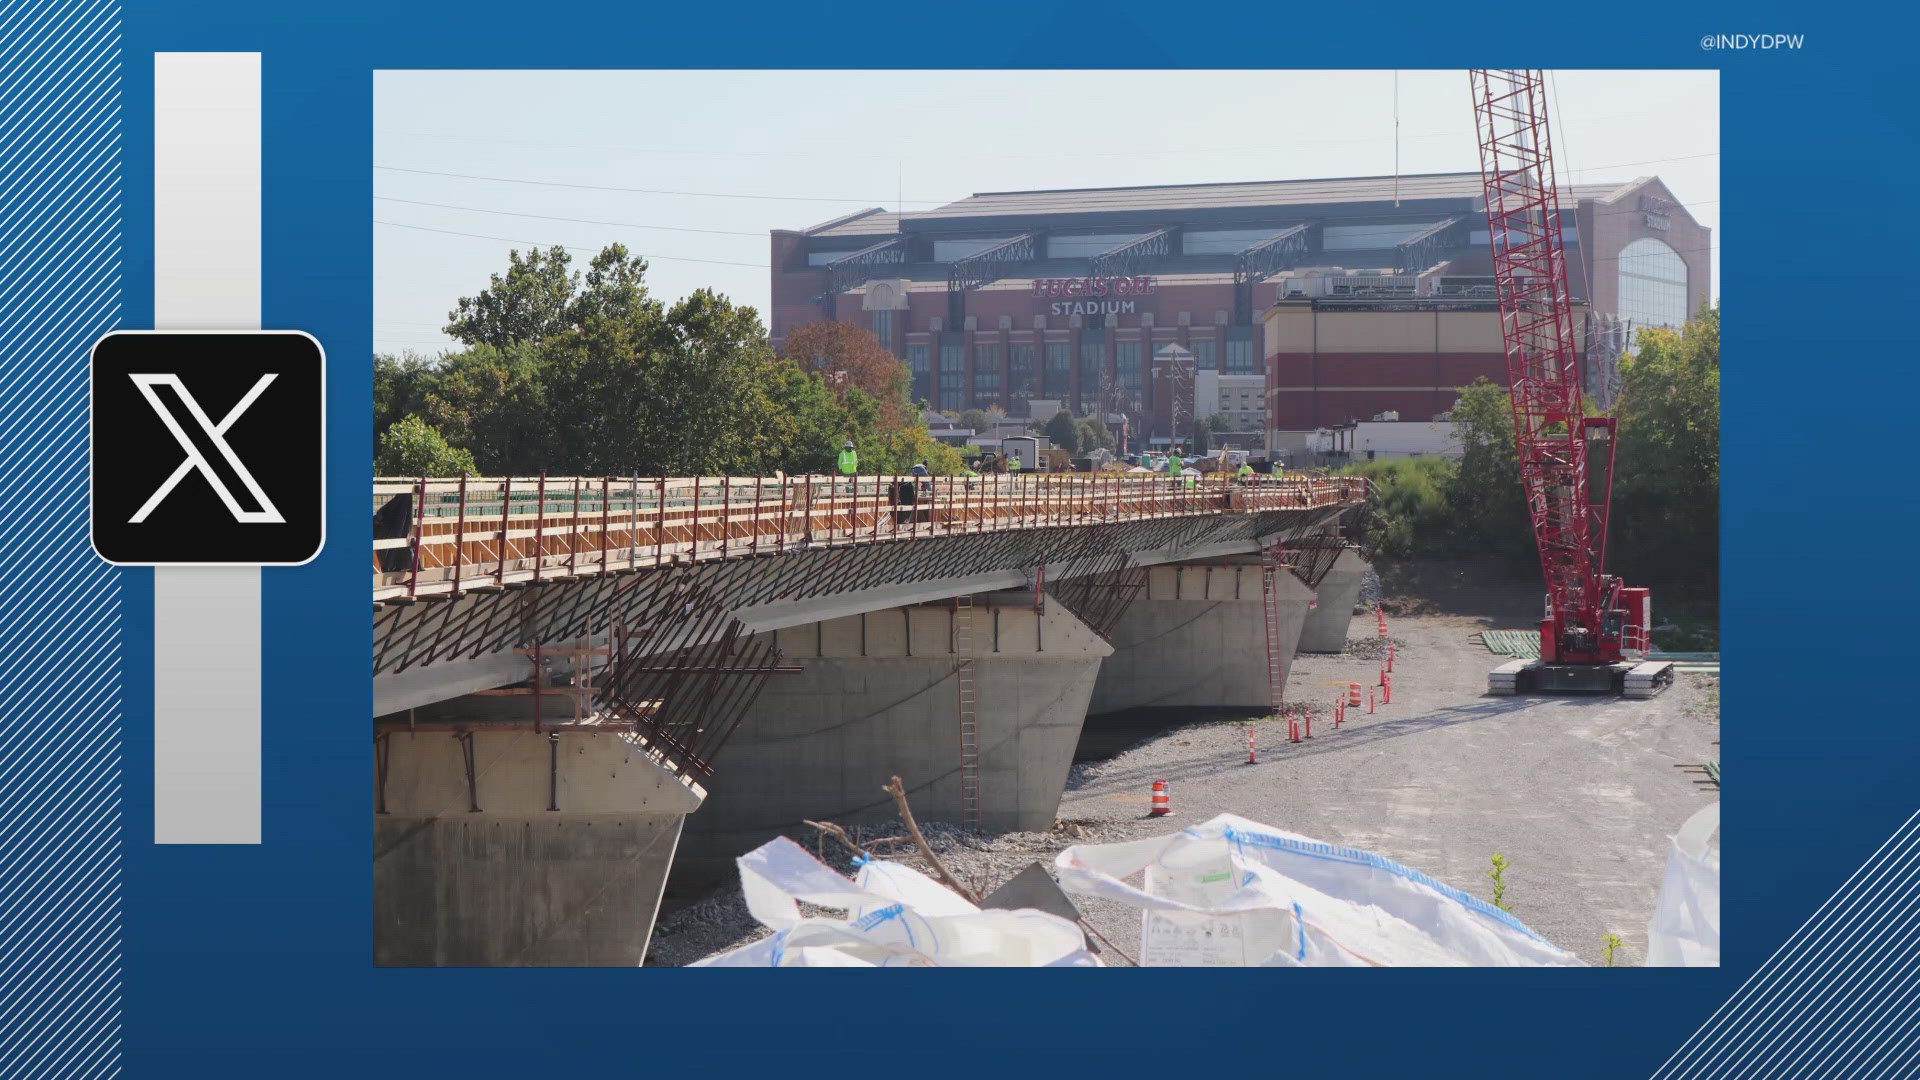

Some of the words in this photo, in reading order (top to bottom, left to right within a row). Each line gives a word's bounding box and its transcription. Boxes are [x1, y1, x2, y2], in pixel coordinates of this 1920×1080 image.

[1032, 277, 1108, 297] LUCAS
[1114, 275, 1155, 295] OIL
[1051, 301, 1135, 316] STADIUM
